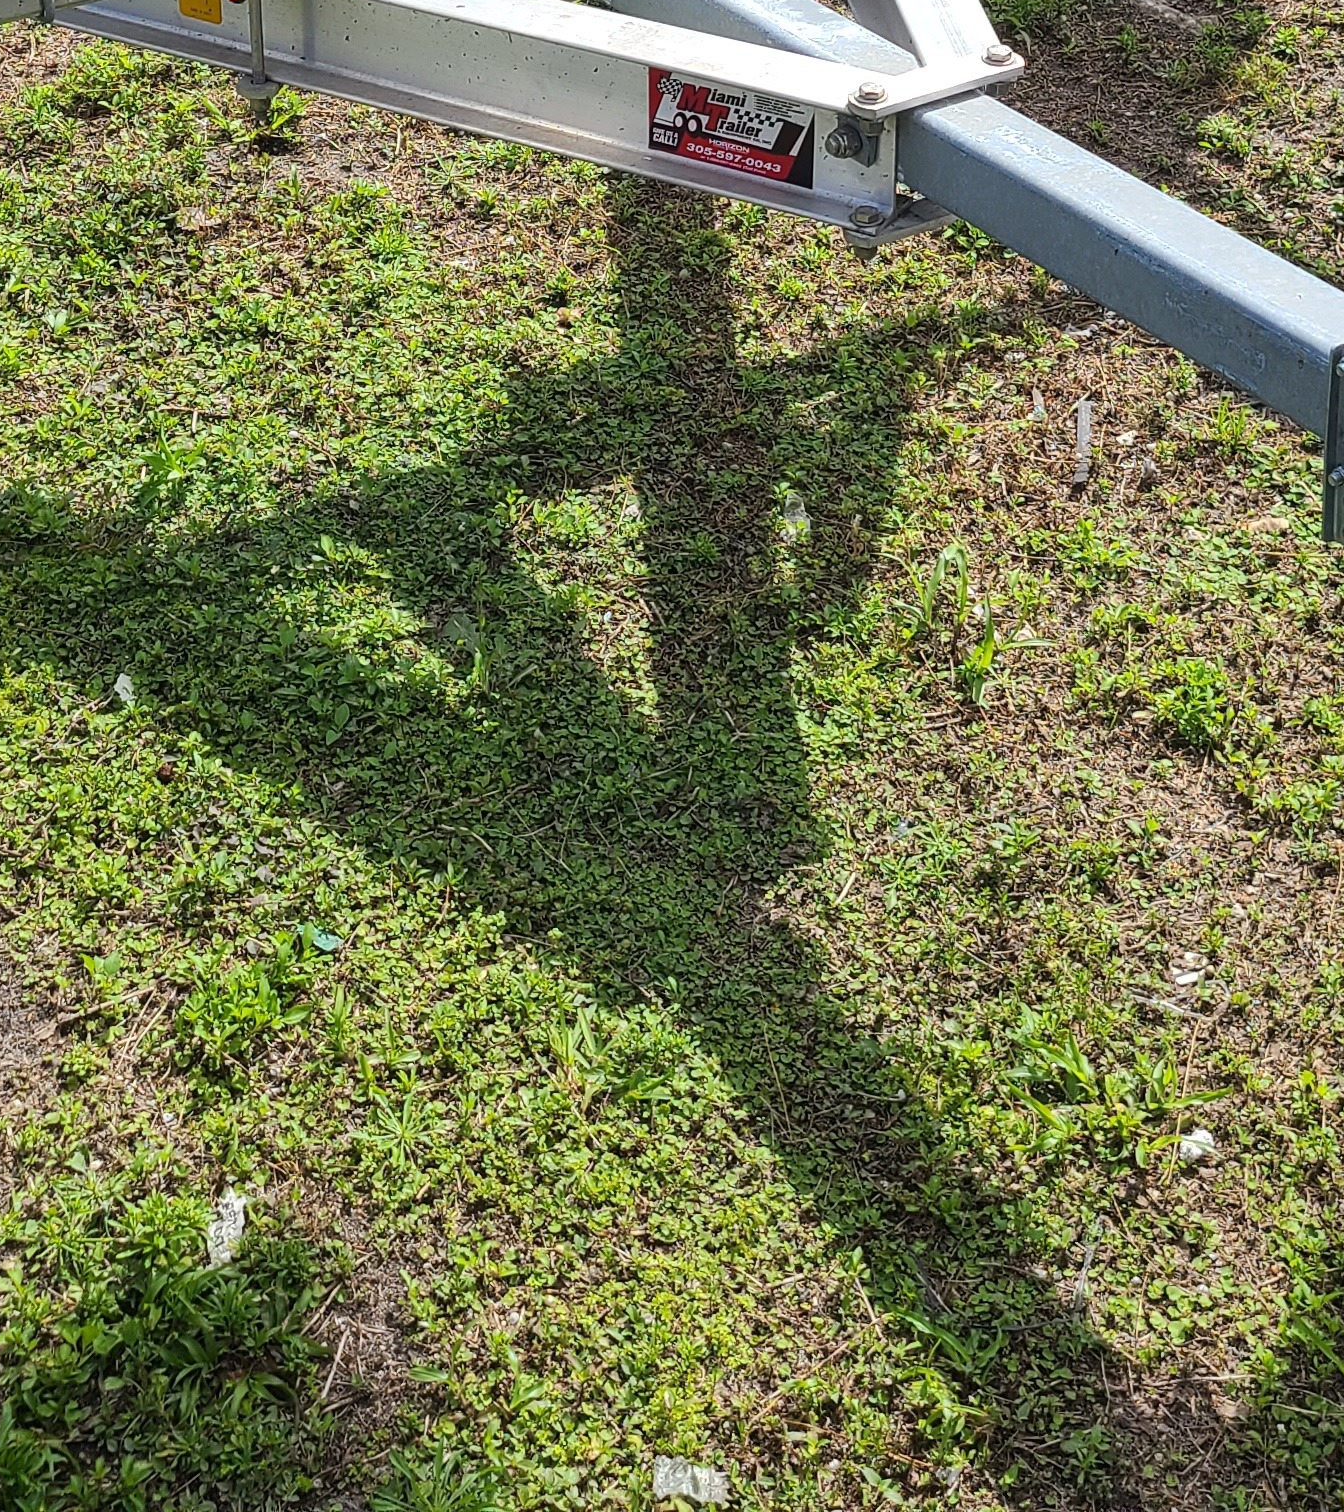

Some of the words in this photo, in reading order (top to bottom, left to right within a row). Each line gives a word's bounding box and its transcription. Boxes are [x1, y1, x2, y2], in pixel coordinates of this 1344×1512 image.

[677, 83, 748, 115] Miami
[705, 102, 763, 139] Trailer
[653, 133, 678, 147] CALL!
[708, 138, 751, 154] HORIZON
[685, 142, 782, 173] 305-597-0043
